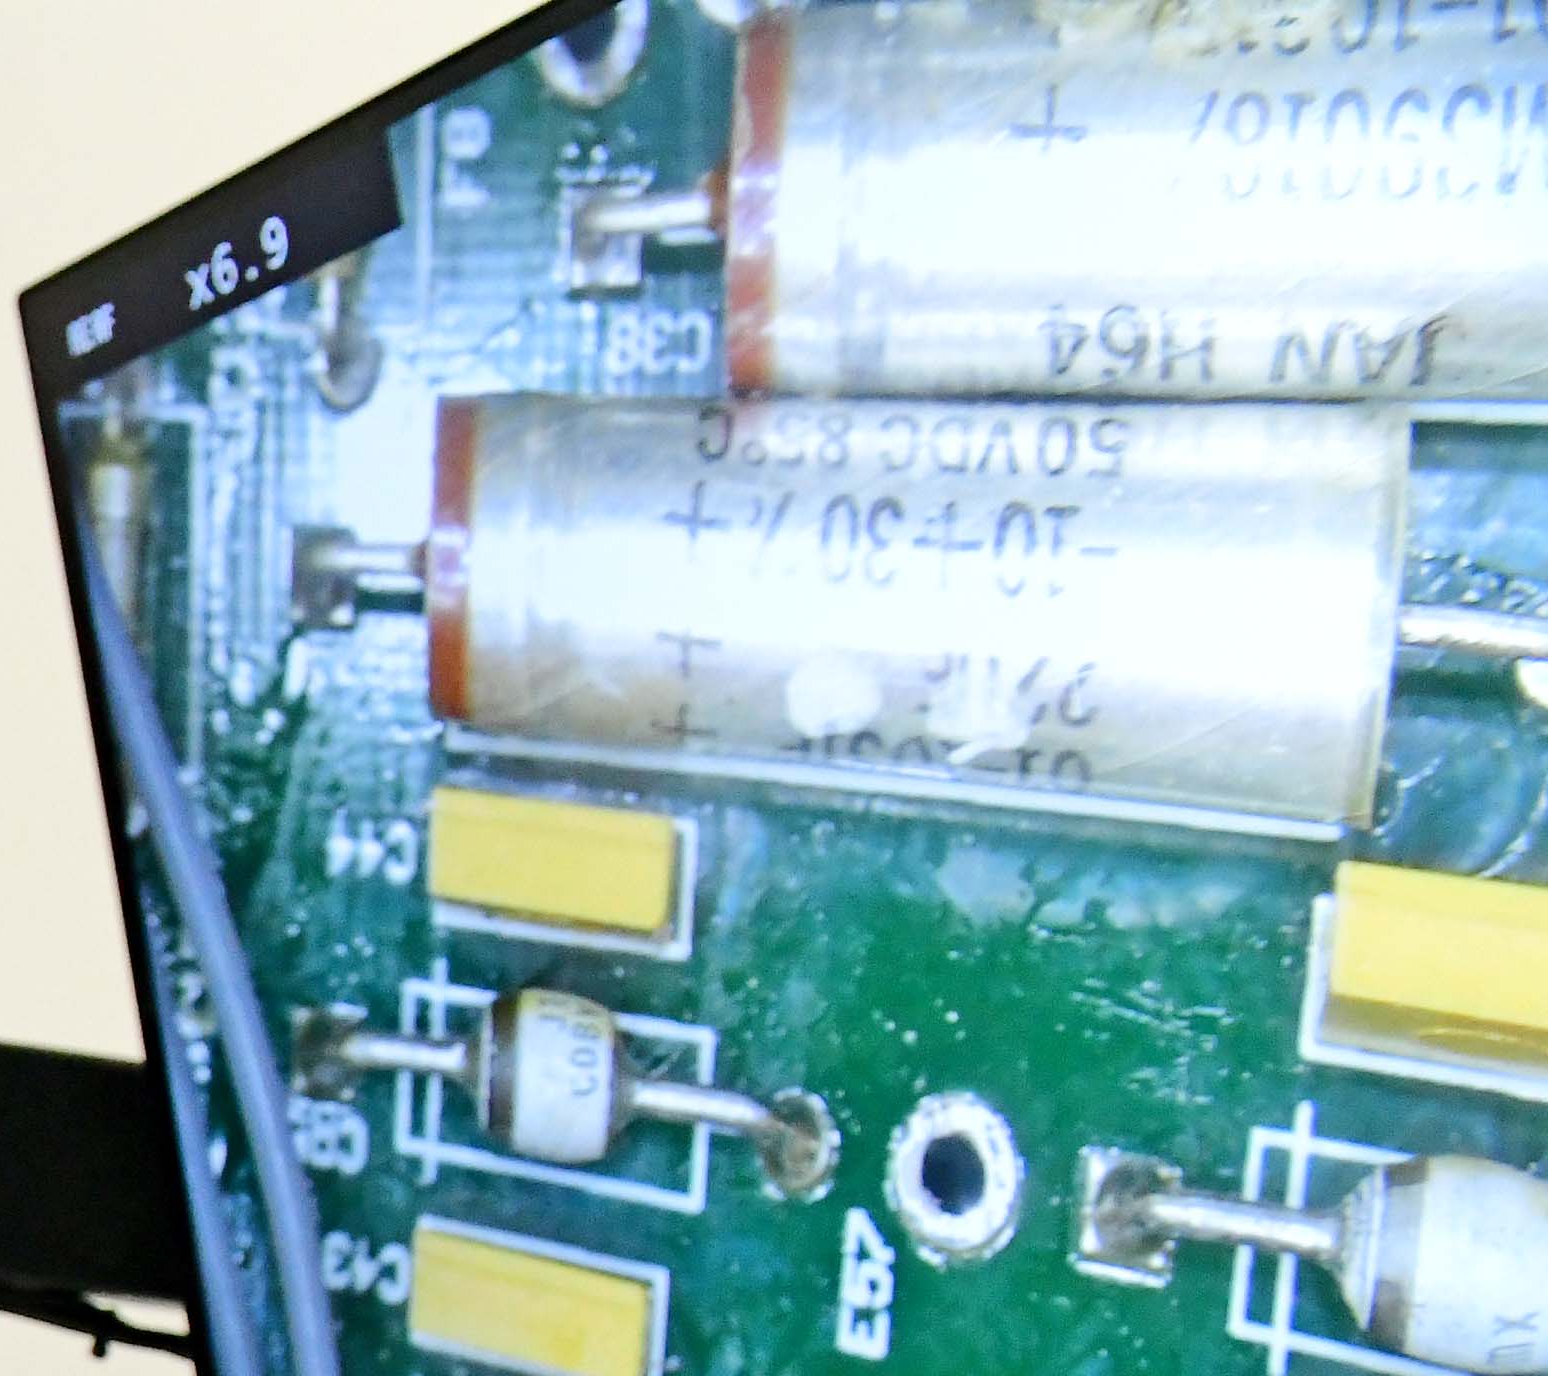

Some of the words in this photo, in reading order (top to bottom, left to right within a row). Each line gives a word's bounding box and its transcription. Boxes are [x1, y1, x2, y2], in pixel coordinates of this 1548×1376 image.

[185, 215, 289, 311] x6.9
[603, 307, 713, 376] C38
[326, 808, 417, 886] C44
[836, 1207, 894, 1360] E57
